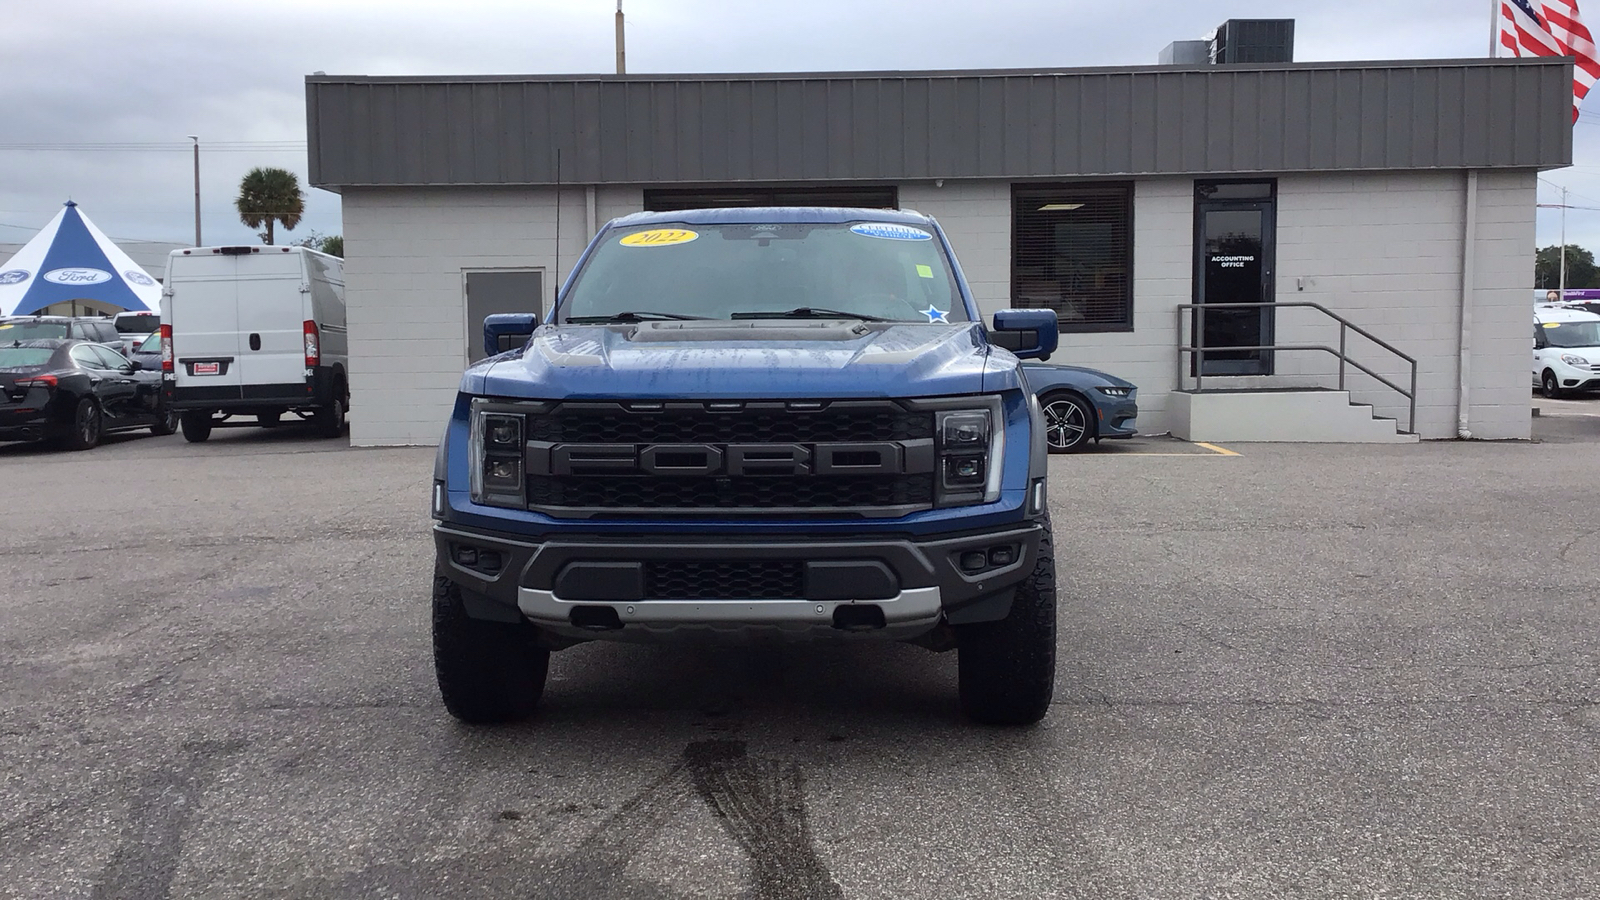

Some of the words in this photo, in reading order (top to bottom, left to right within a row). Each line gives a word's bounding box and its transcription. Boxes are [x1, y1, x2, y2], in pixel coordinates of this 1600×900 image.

[631, 231, 687, 244] 2022
[58, 270, 98, 282] Ford
[551, 442, 903, 476] FORD
